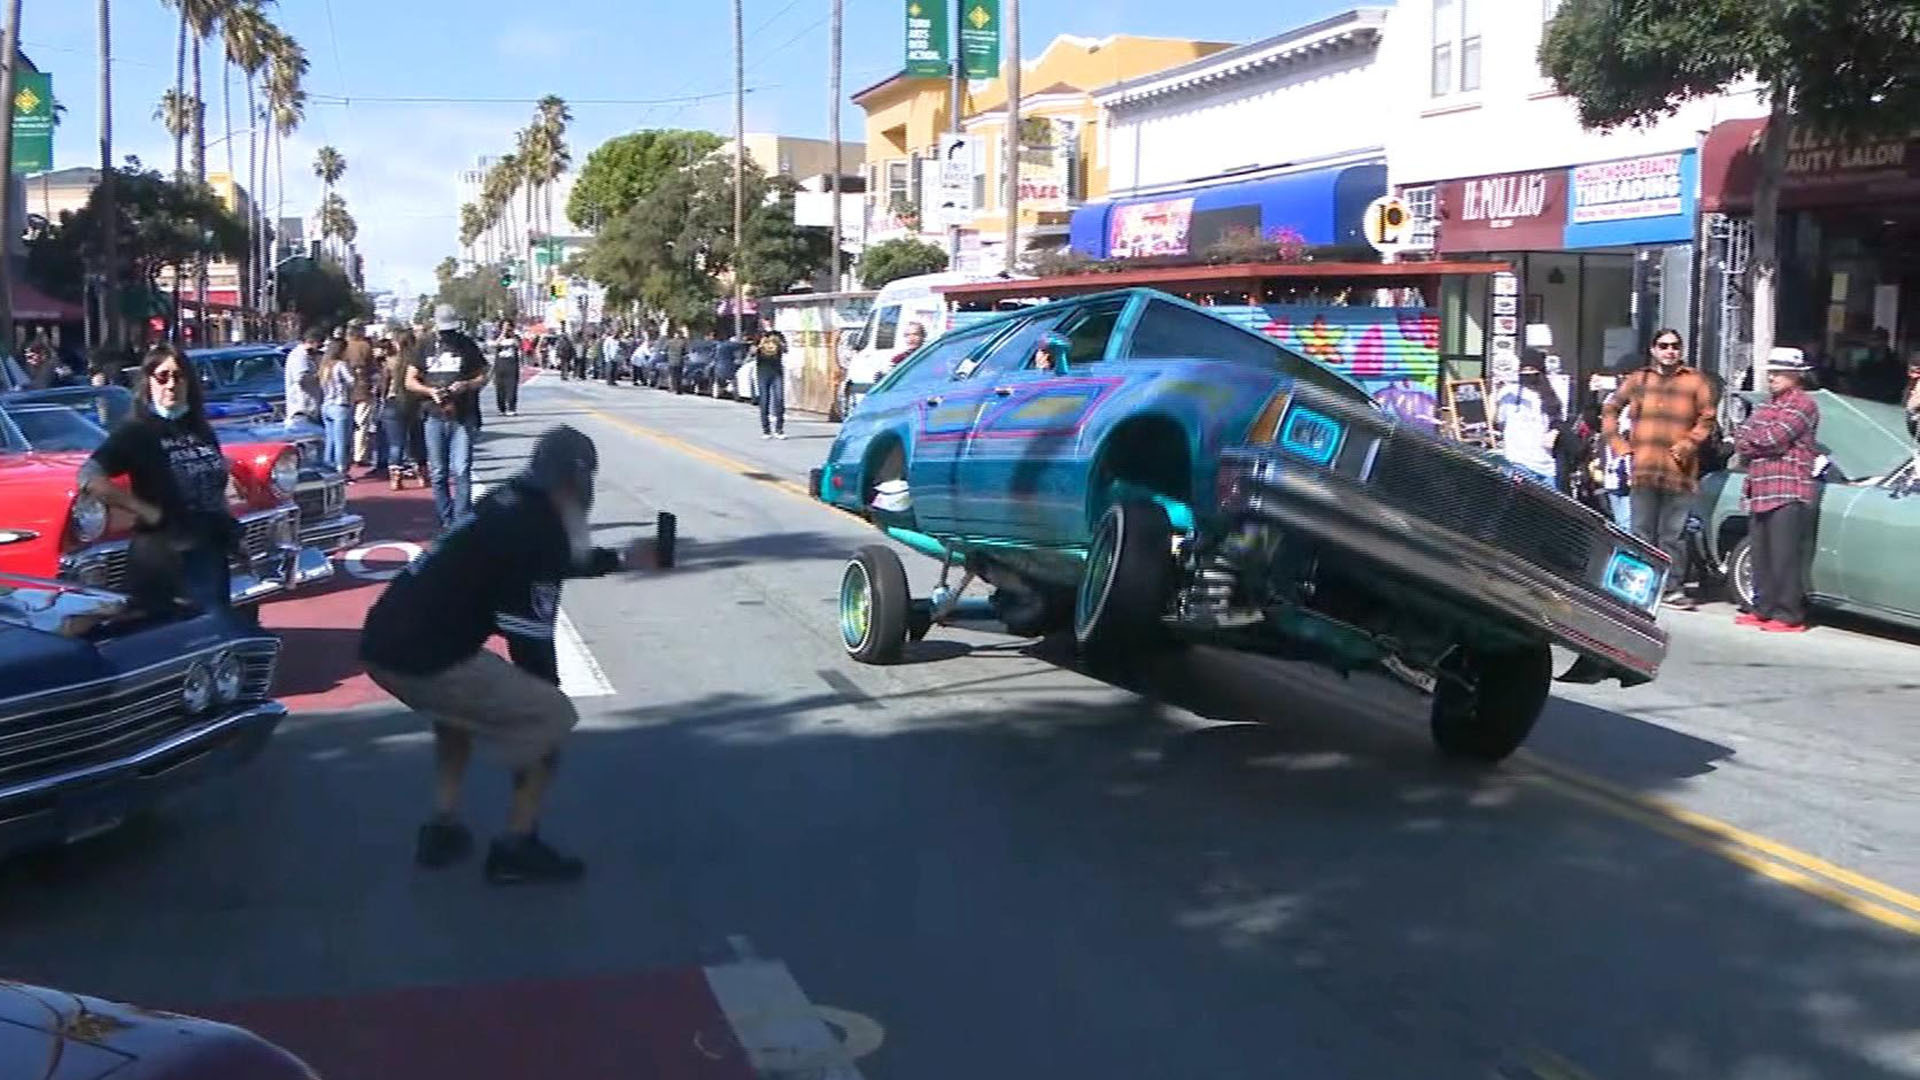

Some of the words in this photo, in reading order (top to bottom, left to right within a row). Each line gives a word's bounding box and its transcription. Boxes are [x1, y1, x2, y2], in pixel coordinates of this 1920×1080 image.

[1784, 149, 1836, 172] AUTY
[1839, 143, 1906, 168] SALON
[1575, 175, 1682, 206] THREADING
